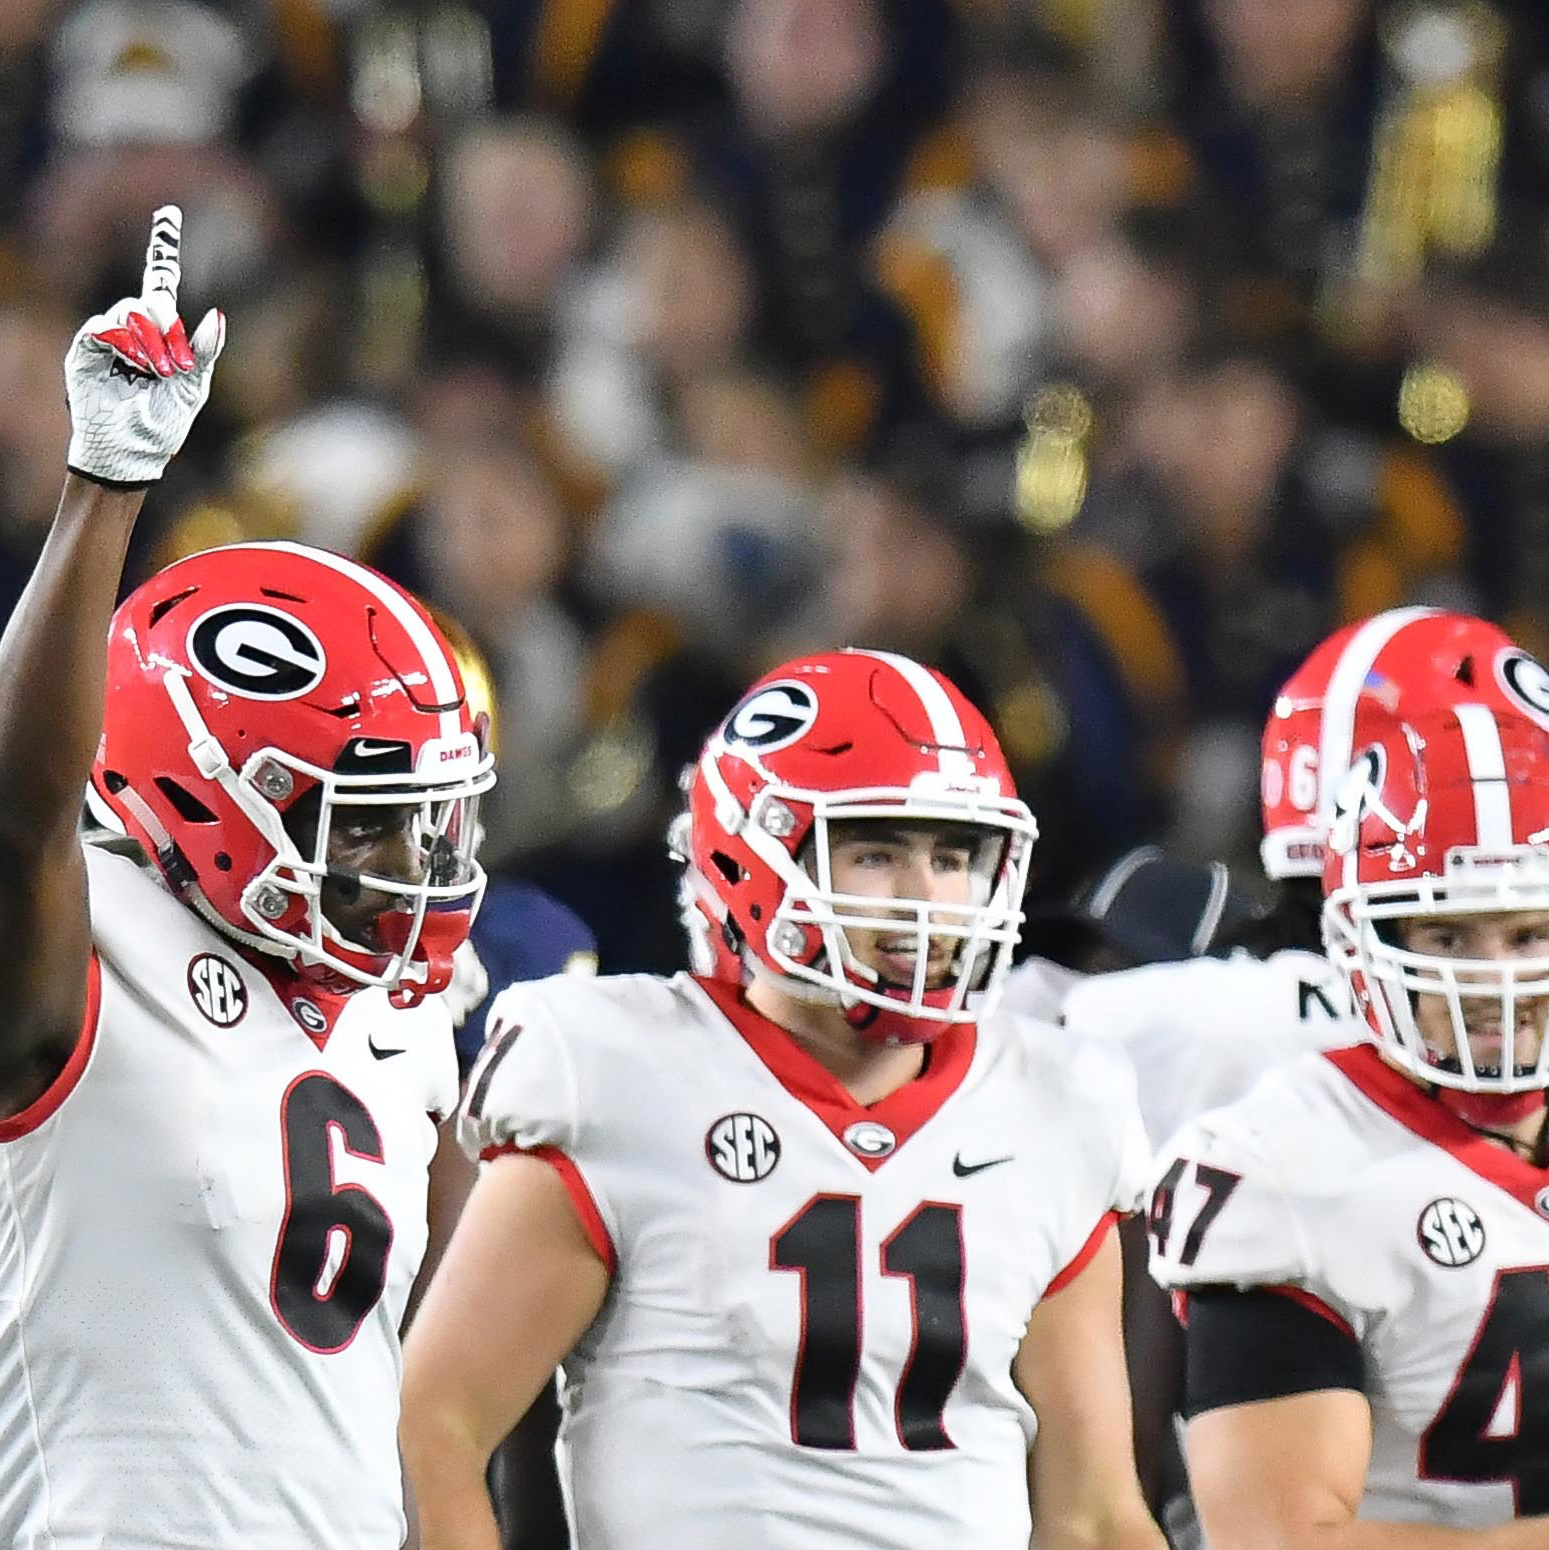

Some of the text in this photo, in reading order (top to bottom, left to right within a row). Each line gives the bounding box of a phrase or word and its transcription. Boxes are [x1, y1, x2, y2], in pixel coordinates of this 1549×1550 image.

[190, 605, 322, 697] G
[721, 683, 812, 748] G
[190, 955, 247, 1026] SEC
[293, 998, 327, 1032] G
[707, 1114, 780, 1182] SEC
[269, 1068, 394, 1356] 6
[1145, 1156, 1246, 1267] 47
[1418, 1198, 1484, 1266] SEC
[768, 1191, 970, 1452] 11
